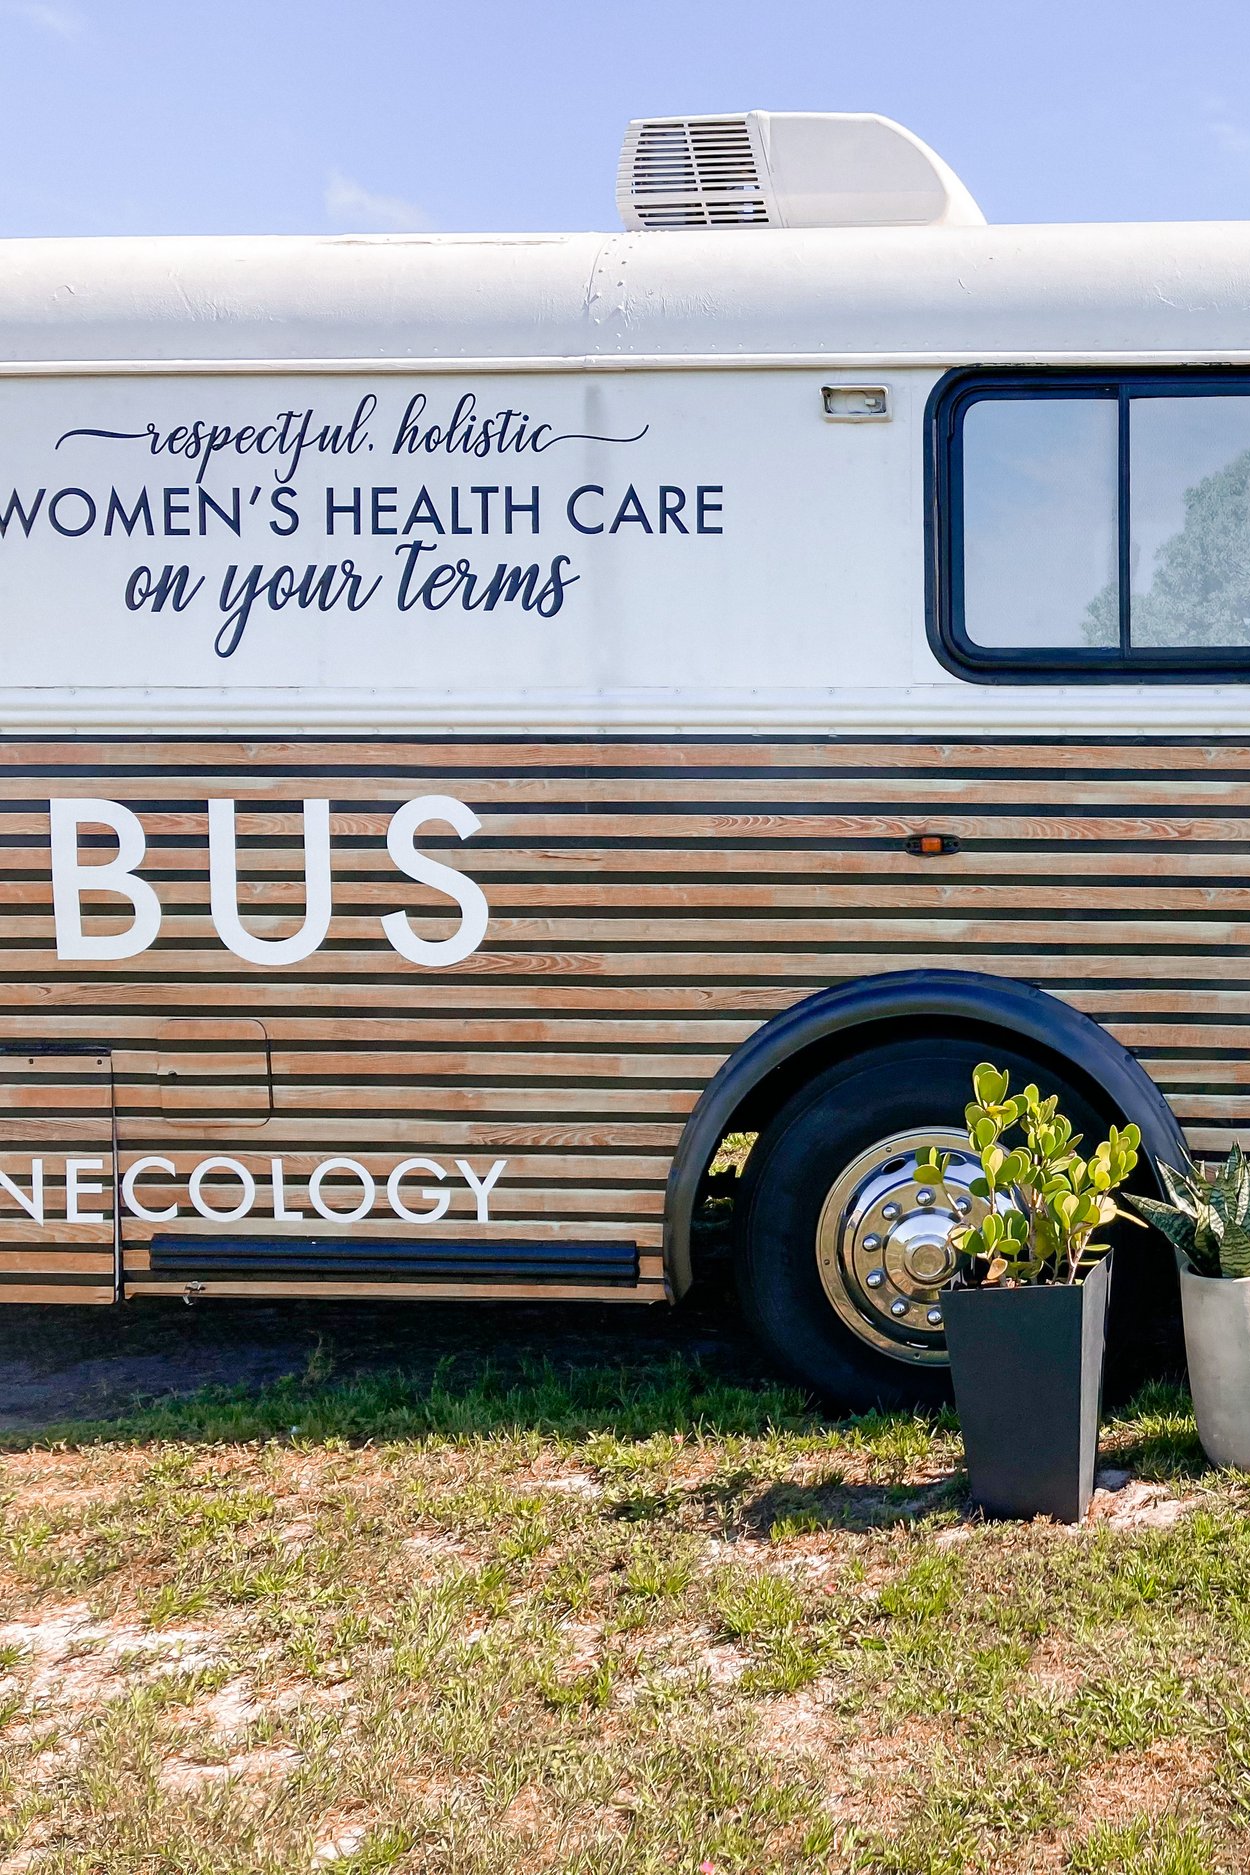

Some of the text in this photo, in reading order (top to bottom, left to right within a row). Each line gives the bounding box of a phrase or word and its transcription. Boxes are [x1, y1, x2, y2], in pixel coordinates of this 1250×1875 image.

[391, 392, 650, 458] holistic
[326, 485, 541, 535] HEALTH
[566, 484, 724, 536] CARE
[124, 539, 581, 659] on your terms
[49, 794, 490, 967] BUS
